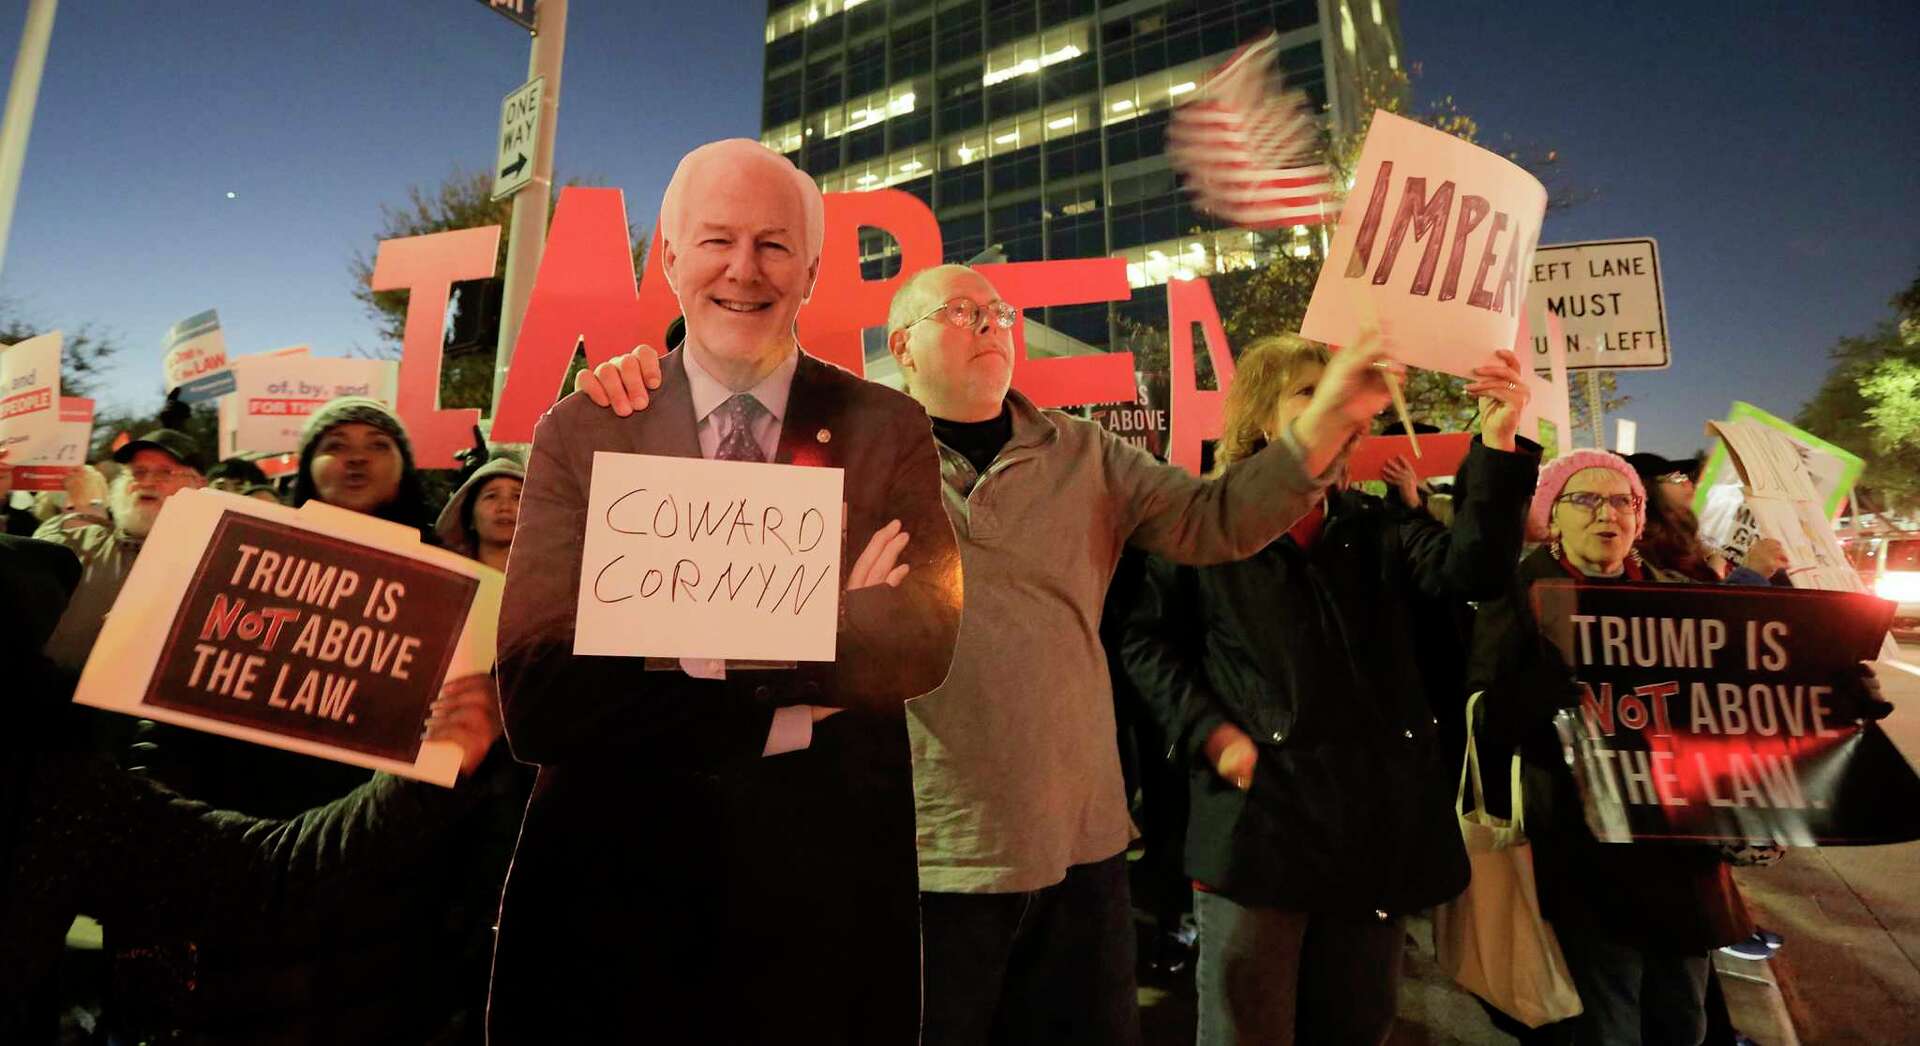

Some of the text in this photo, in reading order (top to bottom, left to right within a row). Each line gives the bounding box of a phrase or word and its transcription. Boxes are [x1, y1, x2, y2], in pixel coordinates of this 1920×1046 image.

[506, 87, 538, 125] ONE
[504, 116, 536, 153] WAY
[1529, 257, 1646, 283] EFT LANE
[1547, 293, 1621, 318] MUST
[1531, 331, 1656, 355] UN LEFT
[251, 401, 287, 414] FOR
[1109, 410, 1167, 431] ABOVE
[606, 488, 825, 555] COWARD
[229, 544, 405, 623] TRUMP IS
[594, 555, 831, 616] CORNYN
[292, 615, 420, 680] ABOVE
[1570, 615, 1789, 672] TRUMP IS
[187, 645, 359, 724] THE LAW.
[1690, 682, 1840, 738] ABOVE
[1593, 750, 1690, 806] THE
